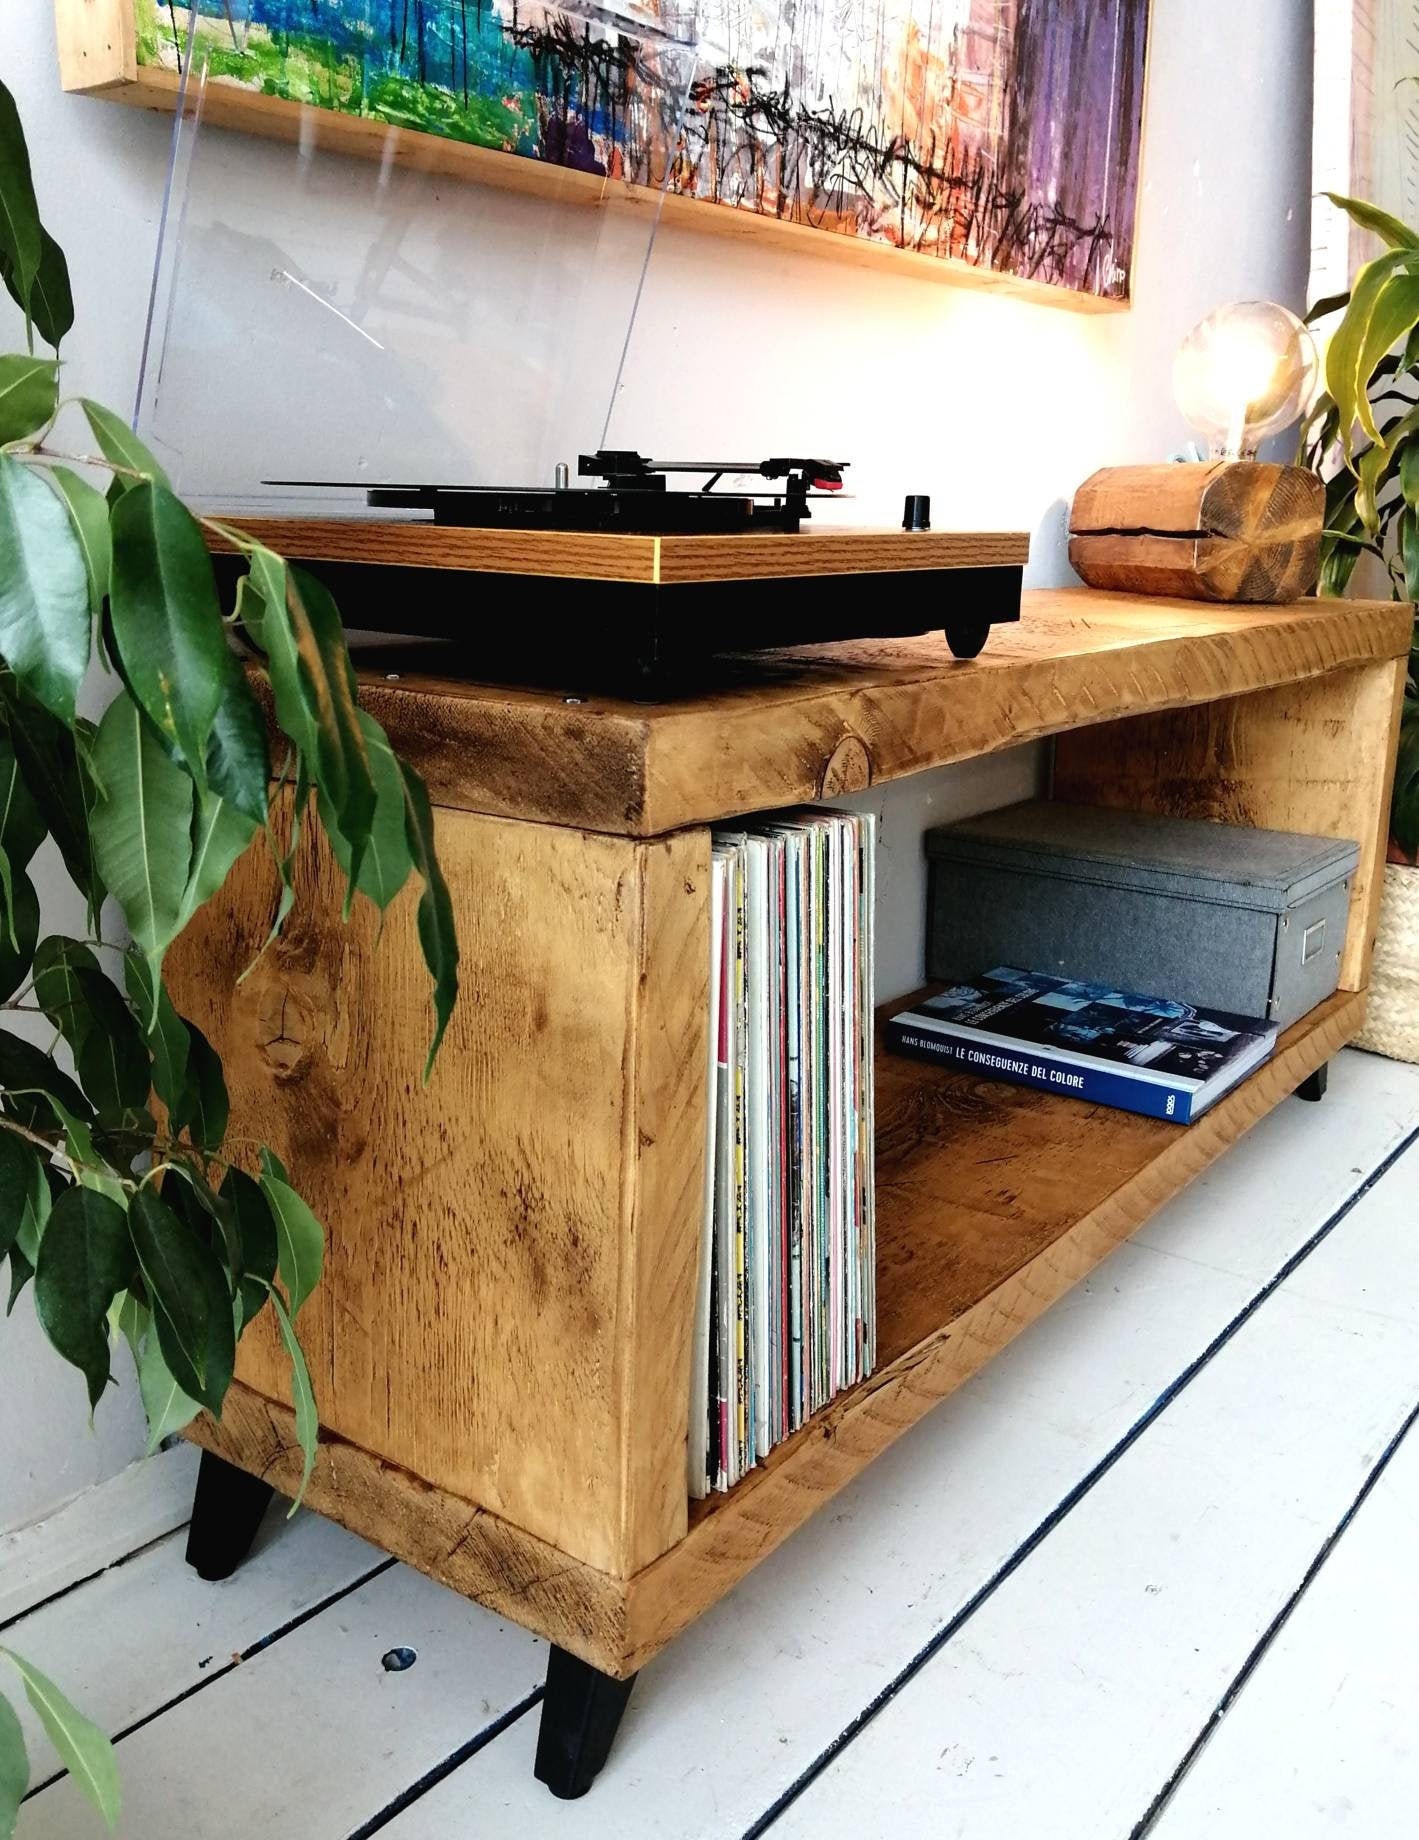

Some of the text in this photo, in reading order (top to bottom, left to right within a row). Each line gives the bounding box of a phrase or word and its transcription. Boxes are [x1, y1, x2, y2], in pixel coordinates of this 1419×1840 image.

[902, 1035, 953, 1055] HANS BLOMQUIST
[956, 1047, 1085, 1089] LE CONSEGUENZE DEL COLORE
